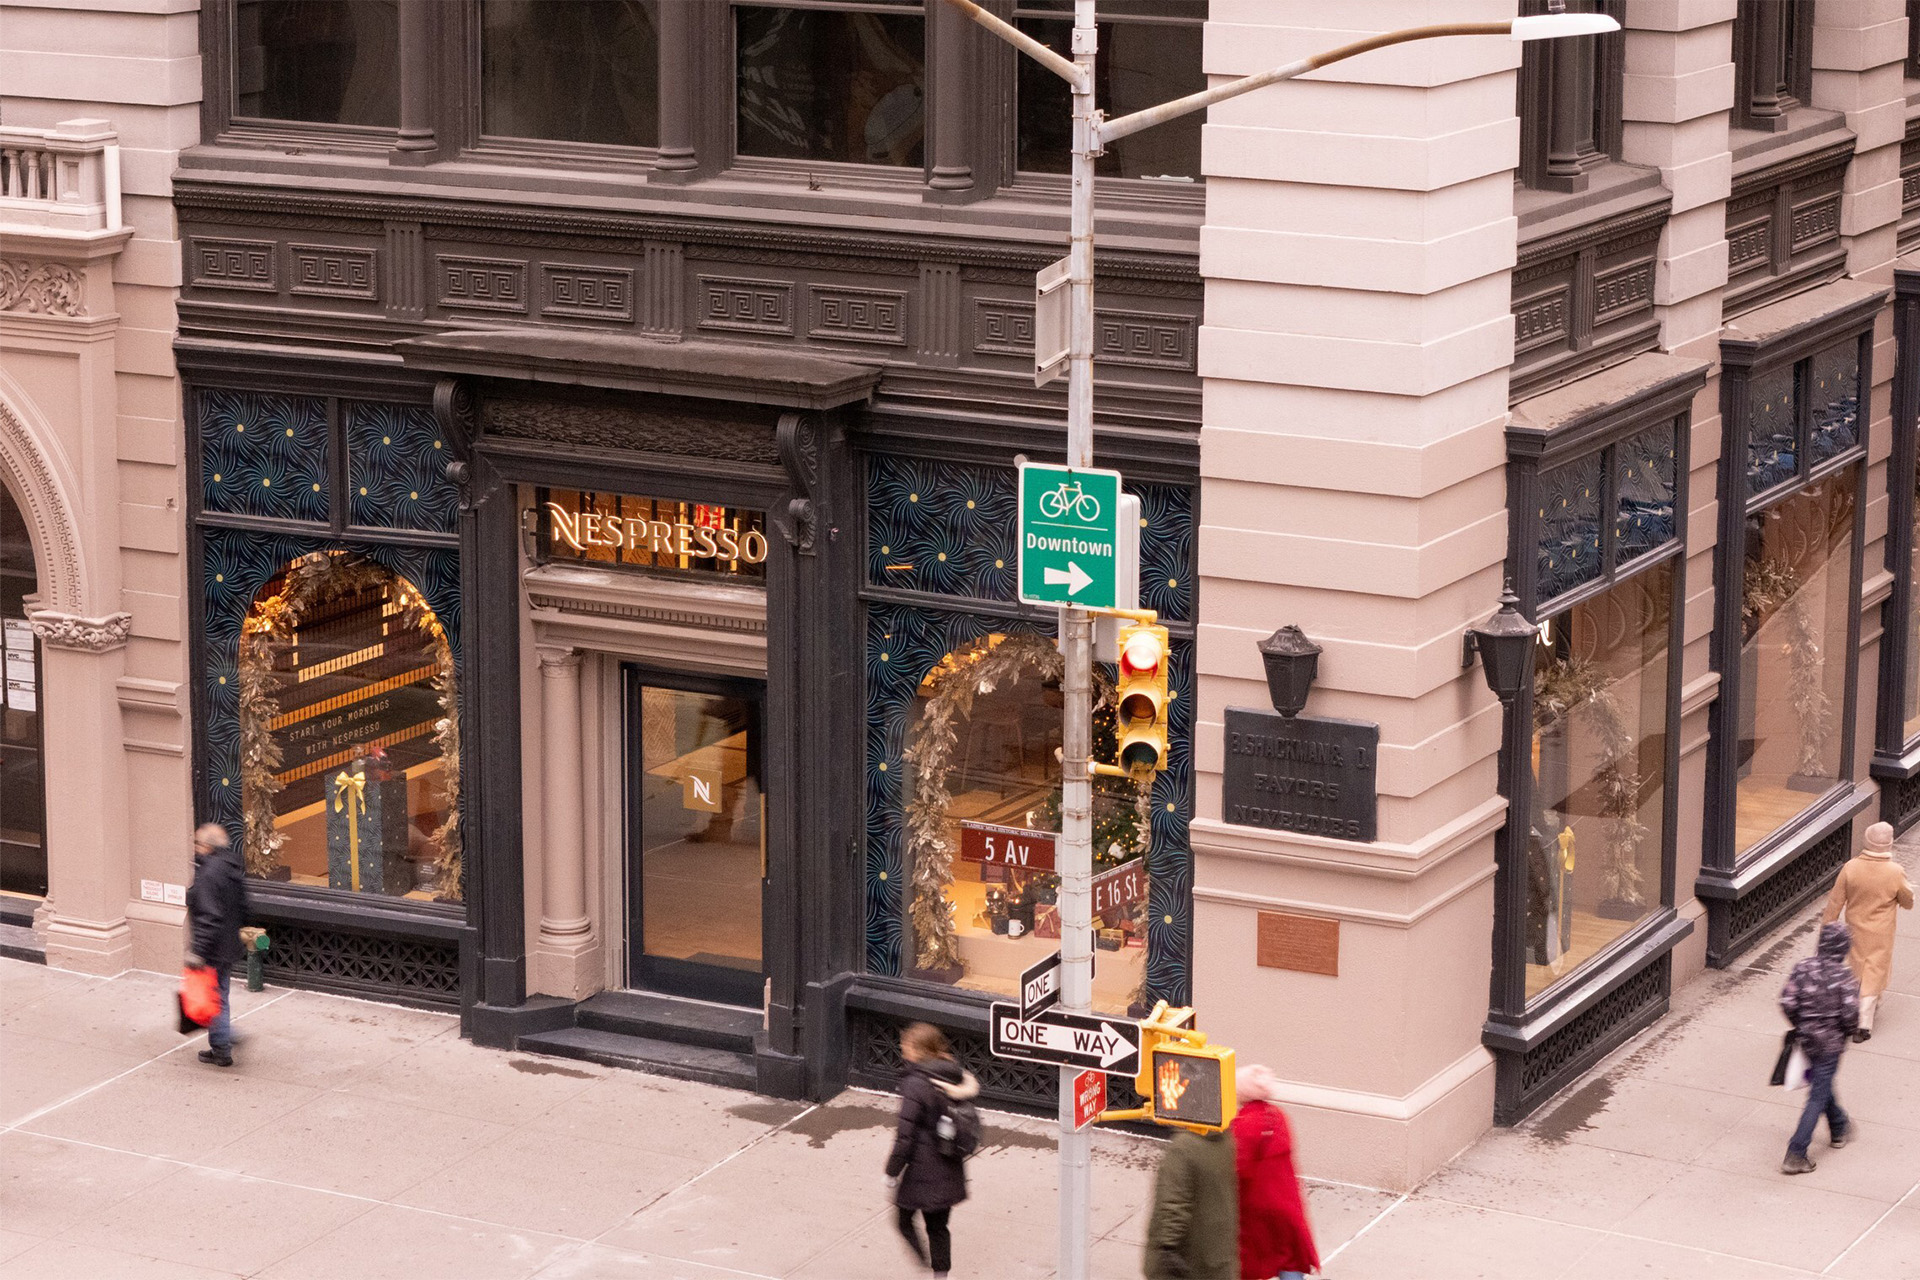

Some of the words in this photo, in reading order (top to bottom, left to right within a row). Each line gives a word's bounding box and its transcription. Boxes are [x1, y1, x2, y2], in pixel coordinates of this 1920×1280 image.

[543, 502, 768, 564] NESPRESSO
[1026, 532, 1113, 558] Downtown
[289, 724, 316, 742] START
[322, 715, 343, 730] YOUR
[348, 699, 390, 721] MORNINGS
[305, 740, 327, 755] WITH
[332, 721, 380, 745] NESPRESSO
[689, 775, 716, 805] N
[1254, 773, 1340, 800] FAVORS
[1233, 804, 1361, 836] NOVELTIES
[985, 836, 995, 861] 5
[1004, 839, 1030, 866] Av
[1096, 886, 1103, 911] E
[1107, 879, 1121, 906] 16
[1125, 872, 1138, 900] St
[1027, 973, 1051, 1003] ONE
[1005, 1021, 1048, 1046] ONE
[1073, 1031, 1120, 1056] WAY
[1080, 1081, 1101, 1107] WRONG
[1083, 1097, 1097, 1119] WAY
